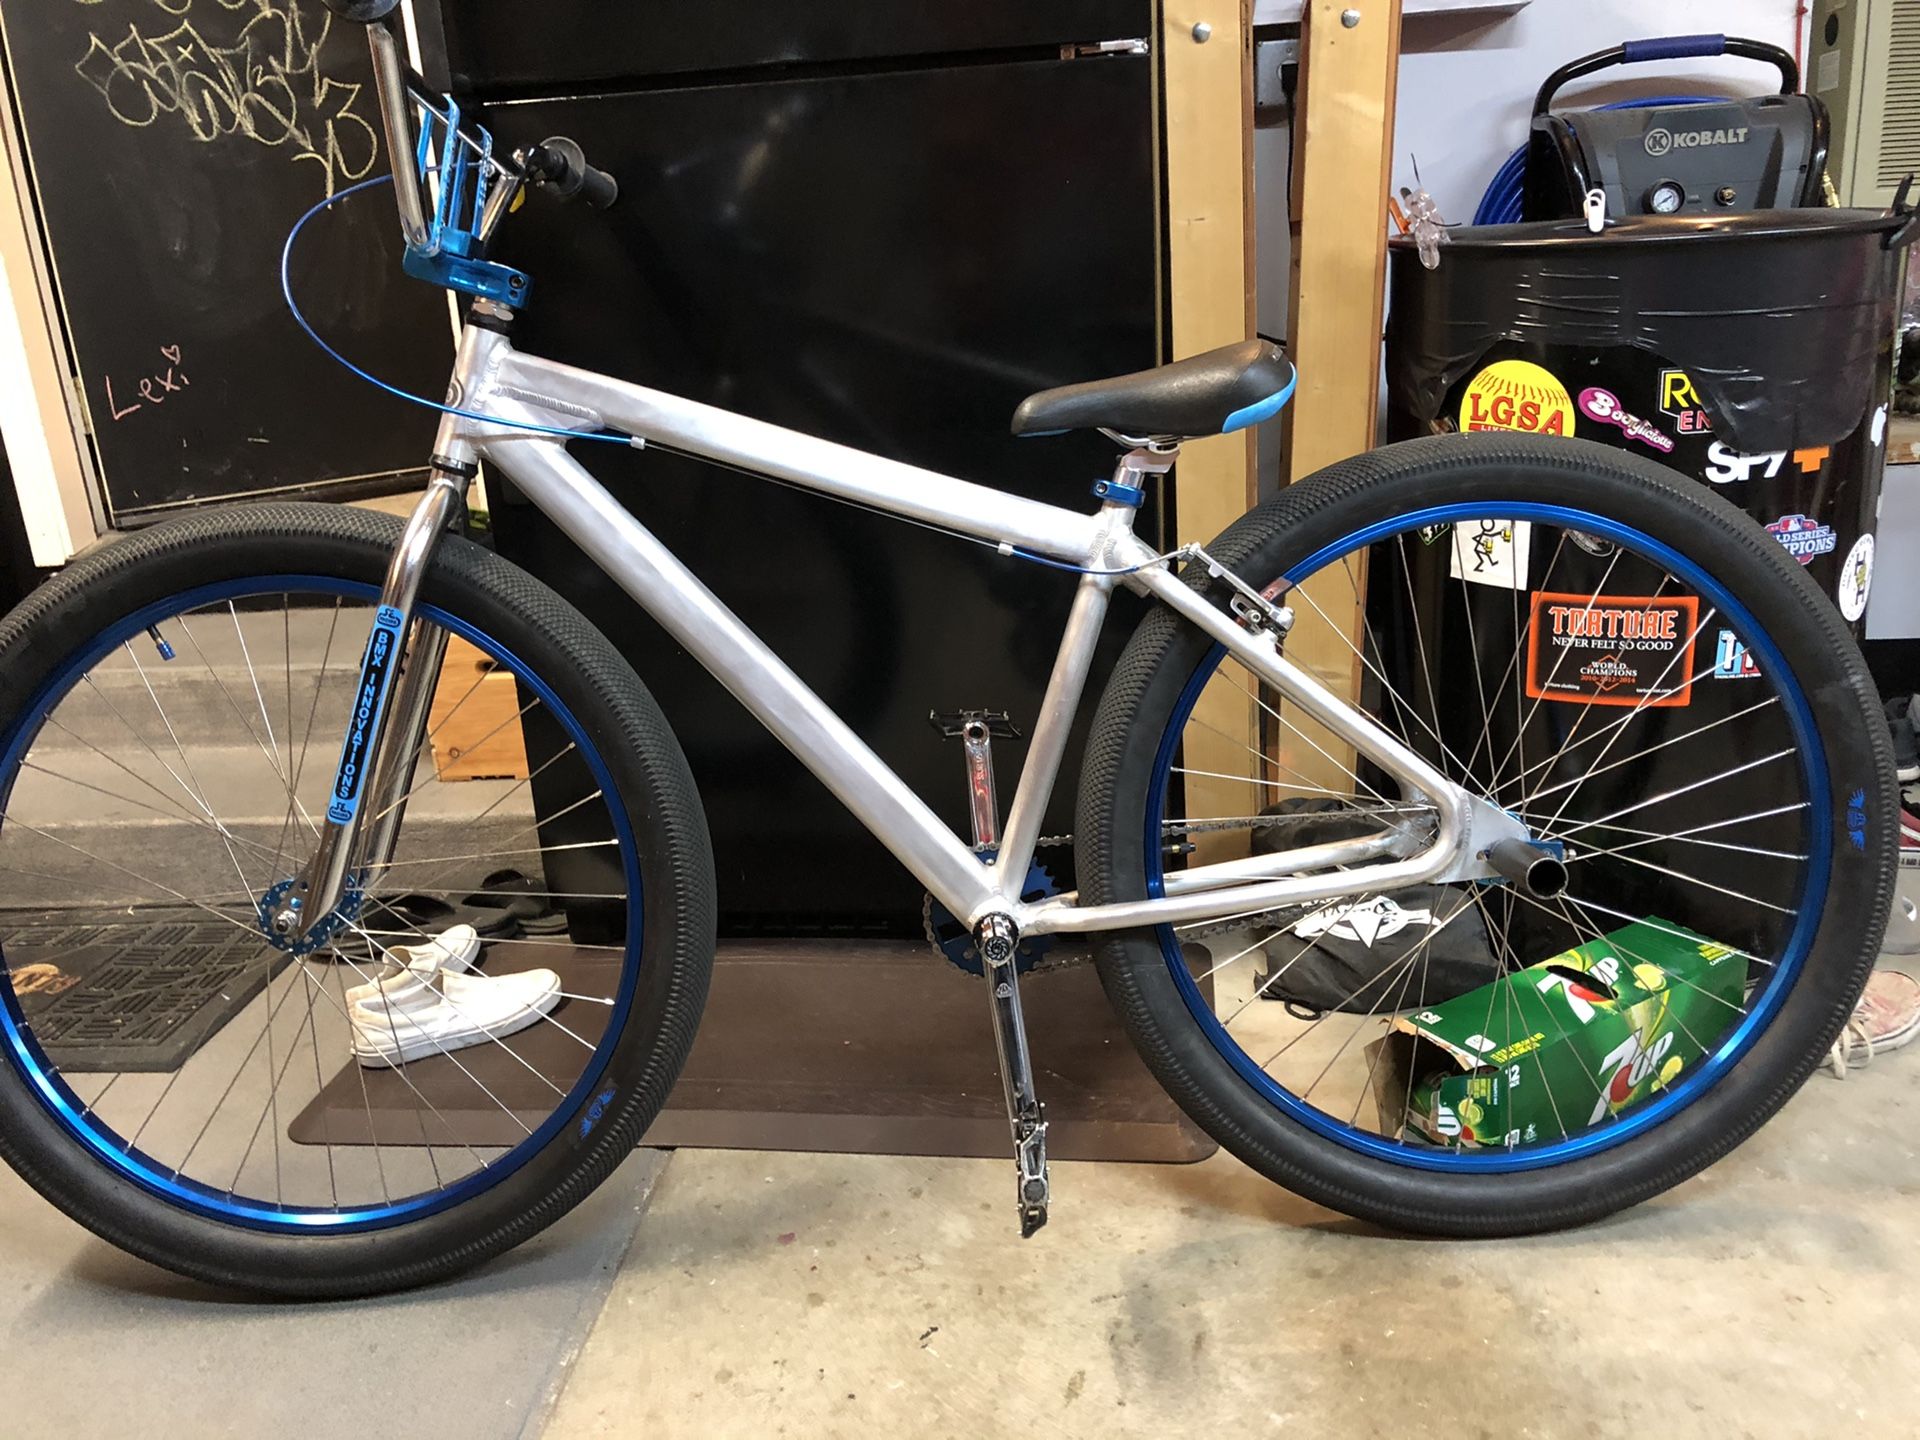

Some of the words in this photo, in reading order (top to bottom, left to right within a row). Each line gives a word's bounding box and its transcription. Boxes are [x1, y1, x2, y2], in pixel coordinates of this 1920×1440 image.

[1673, 127, 1748, 148] KOBALT
[105, 344, 190, 420] Lexi
[1469, 393, 1564, 437] LGSA
[1791, 528, 1828, 542] SERIES
[1548, 606, 1679, 639] TORTURE
[371, 631, 389, 668] BMX
[1552, 636, 1589, 648] NEVER
[1591, 639, 1618, 650] FELT
[1618, 641, 1635, 650] SO
[1636, 641, 1674, 651] GOOD
[1579, 666, 1638, 677] CHAMPIONS
[1591, 661, 1627, 670] WORLD
[339, 672, 376, 799] INNOVATIONS
[1587, 1027, 1674, 1126] 7UP
